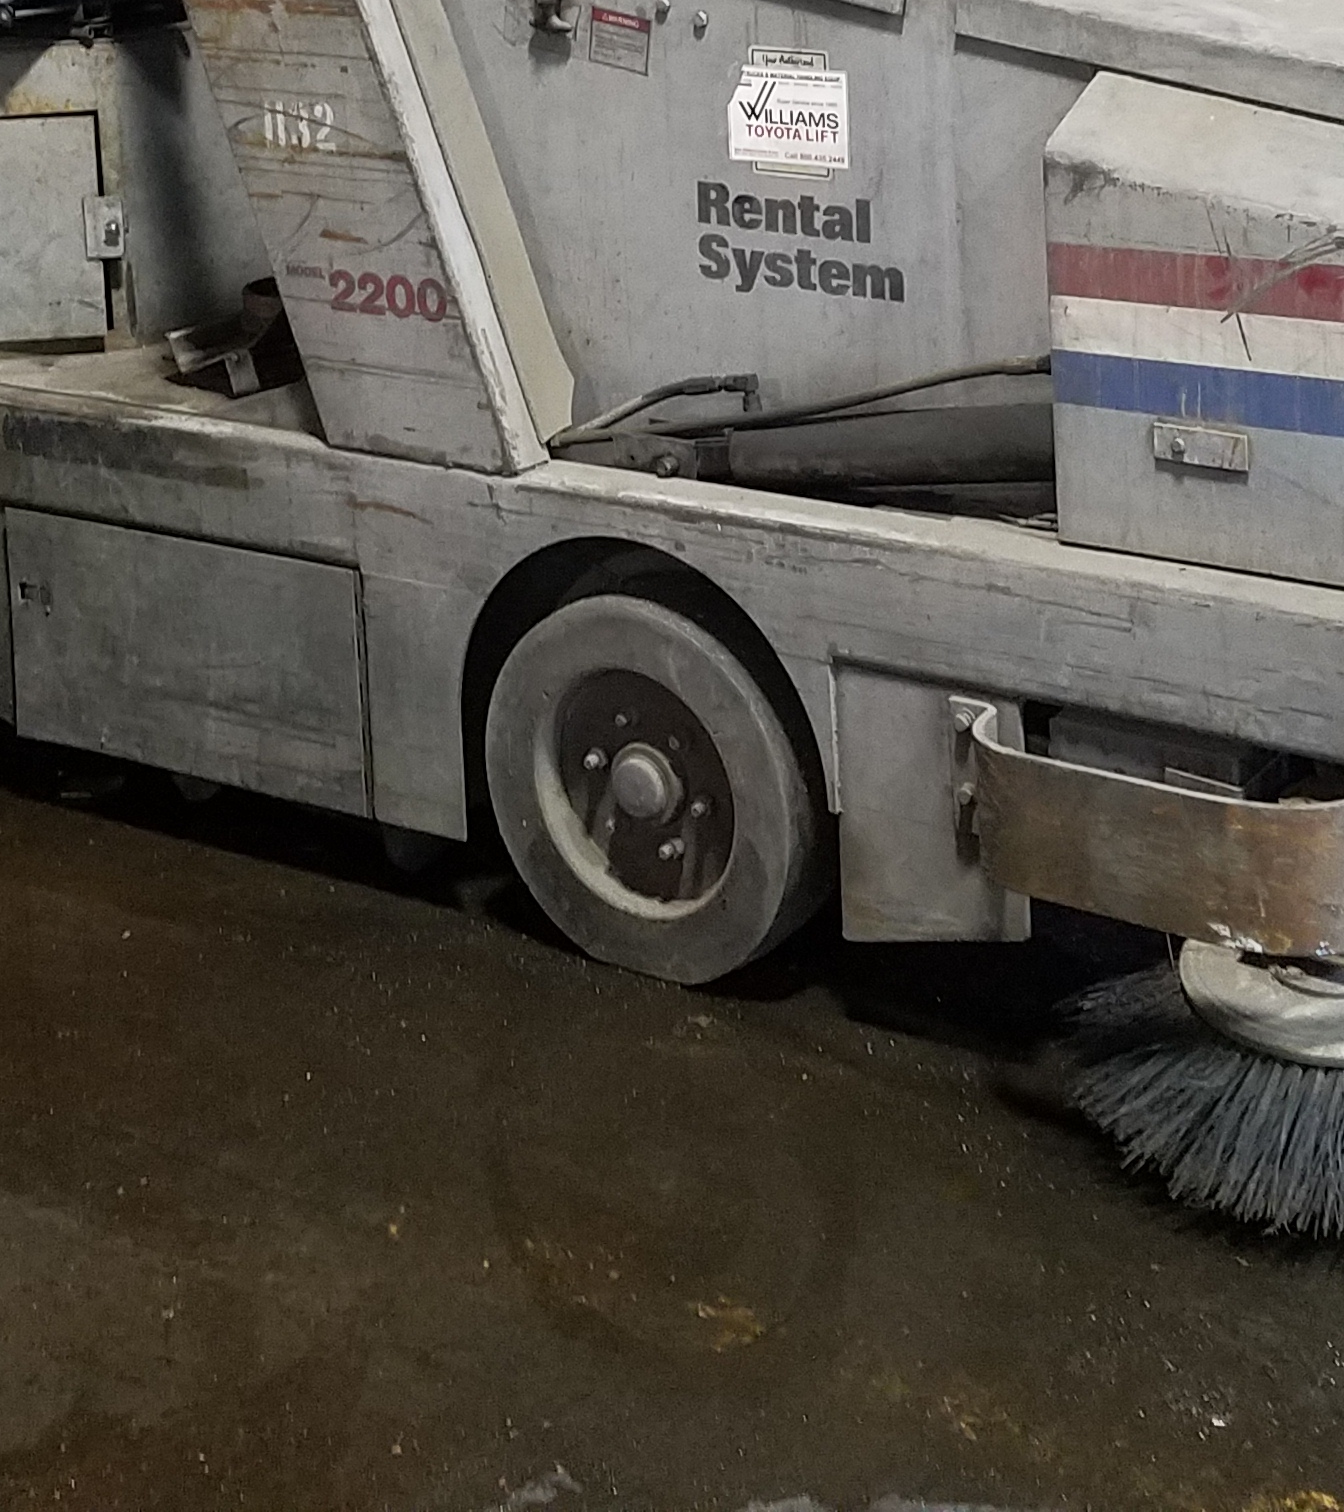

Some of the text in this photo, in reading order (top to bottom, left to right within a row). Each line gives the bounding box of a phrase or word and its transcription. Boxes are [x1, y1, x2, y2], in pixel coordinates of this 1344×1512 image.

[738, 81, 839, 129] WILLIAMS
[746, 123, 839, 144] TOYOTA LIFT
[696, 180, 872, 244] Rental
[698, 232, 905, 303] System
[329, 268, 448, 322] 2200
